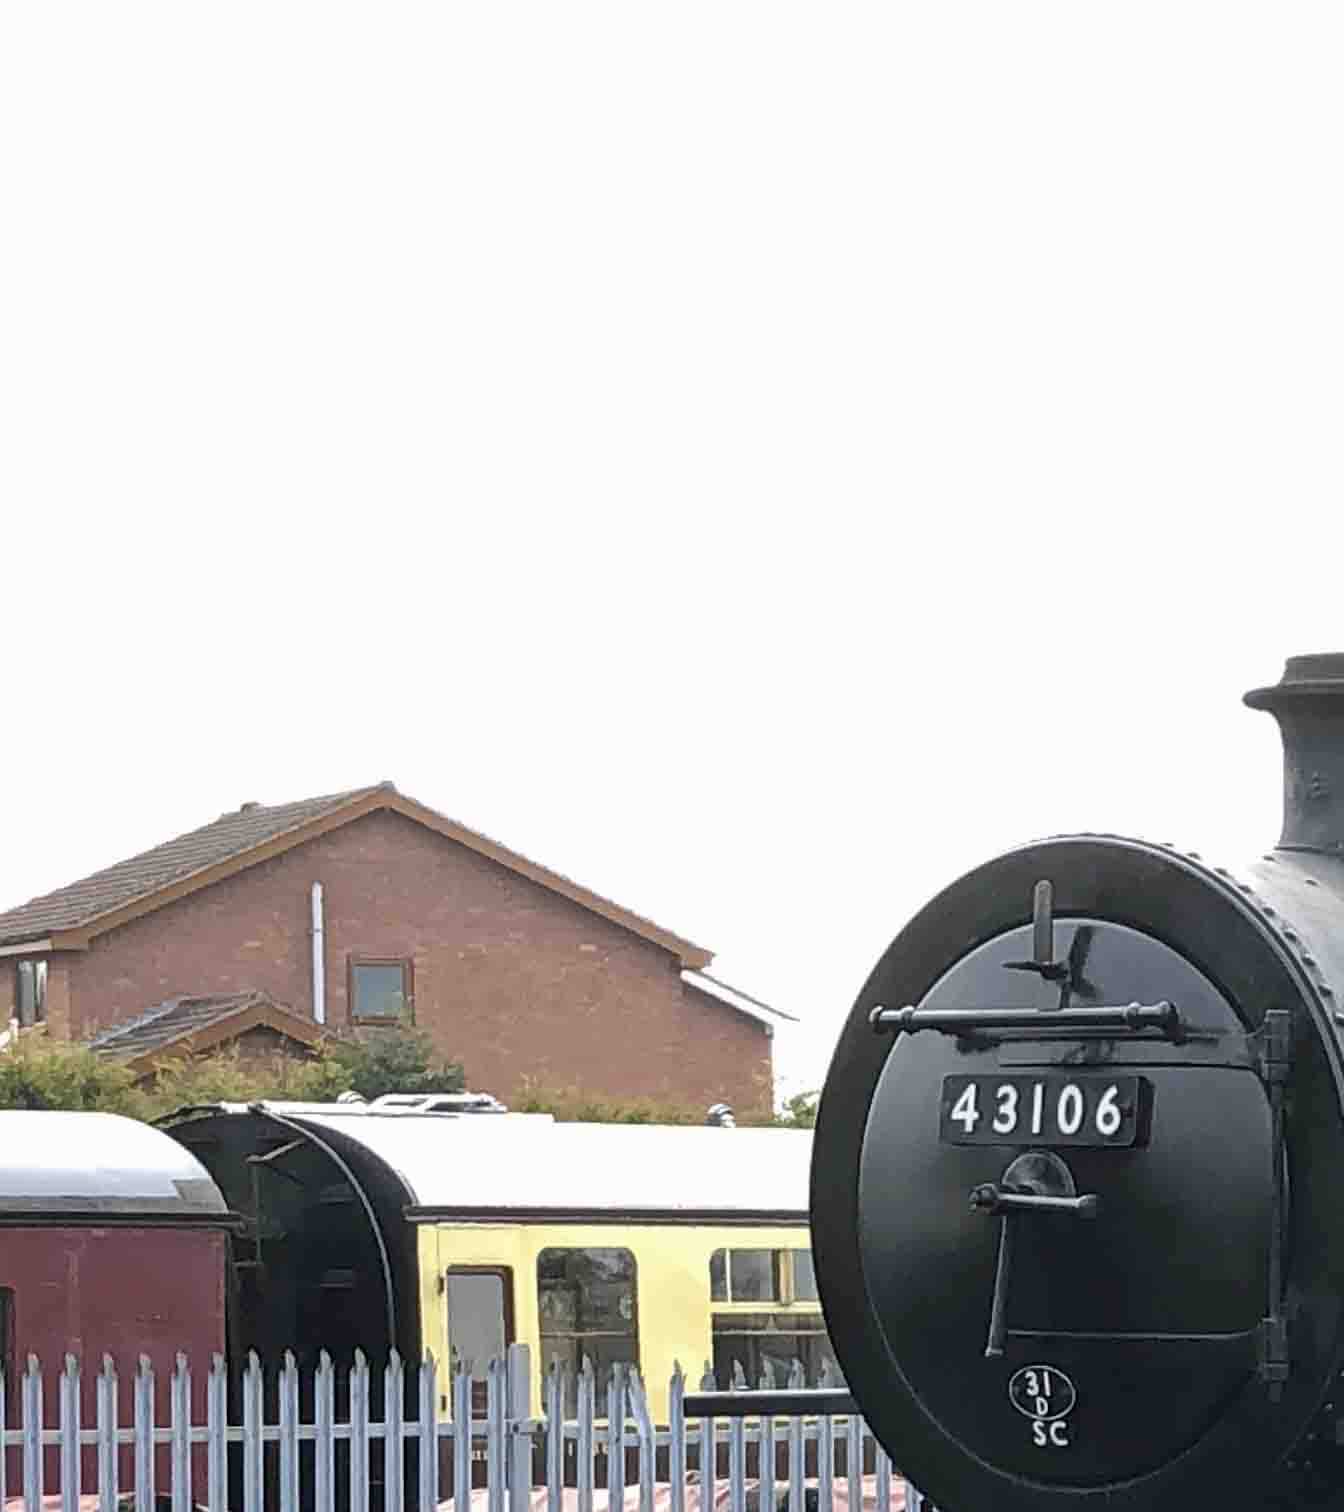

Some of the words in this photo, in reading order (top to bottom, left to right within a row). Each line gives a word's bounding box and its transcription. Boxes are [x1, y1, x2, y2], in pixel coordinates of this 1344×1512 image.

[951, 1083, 1121, 1136] 43106
[1024, 1370, 1051, 1397] 31
[1036, 1396, 1049, 1416] D
[1032, 1420, 1069, 1446] SC
